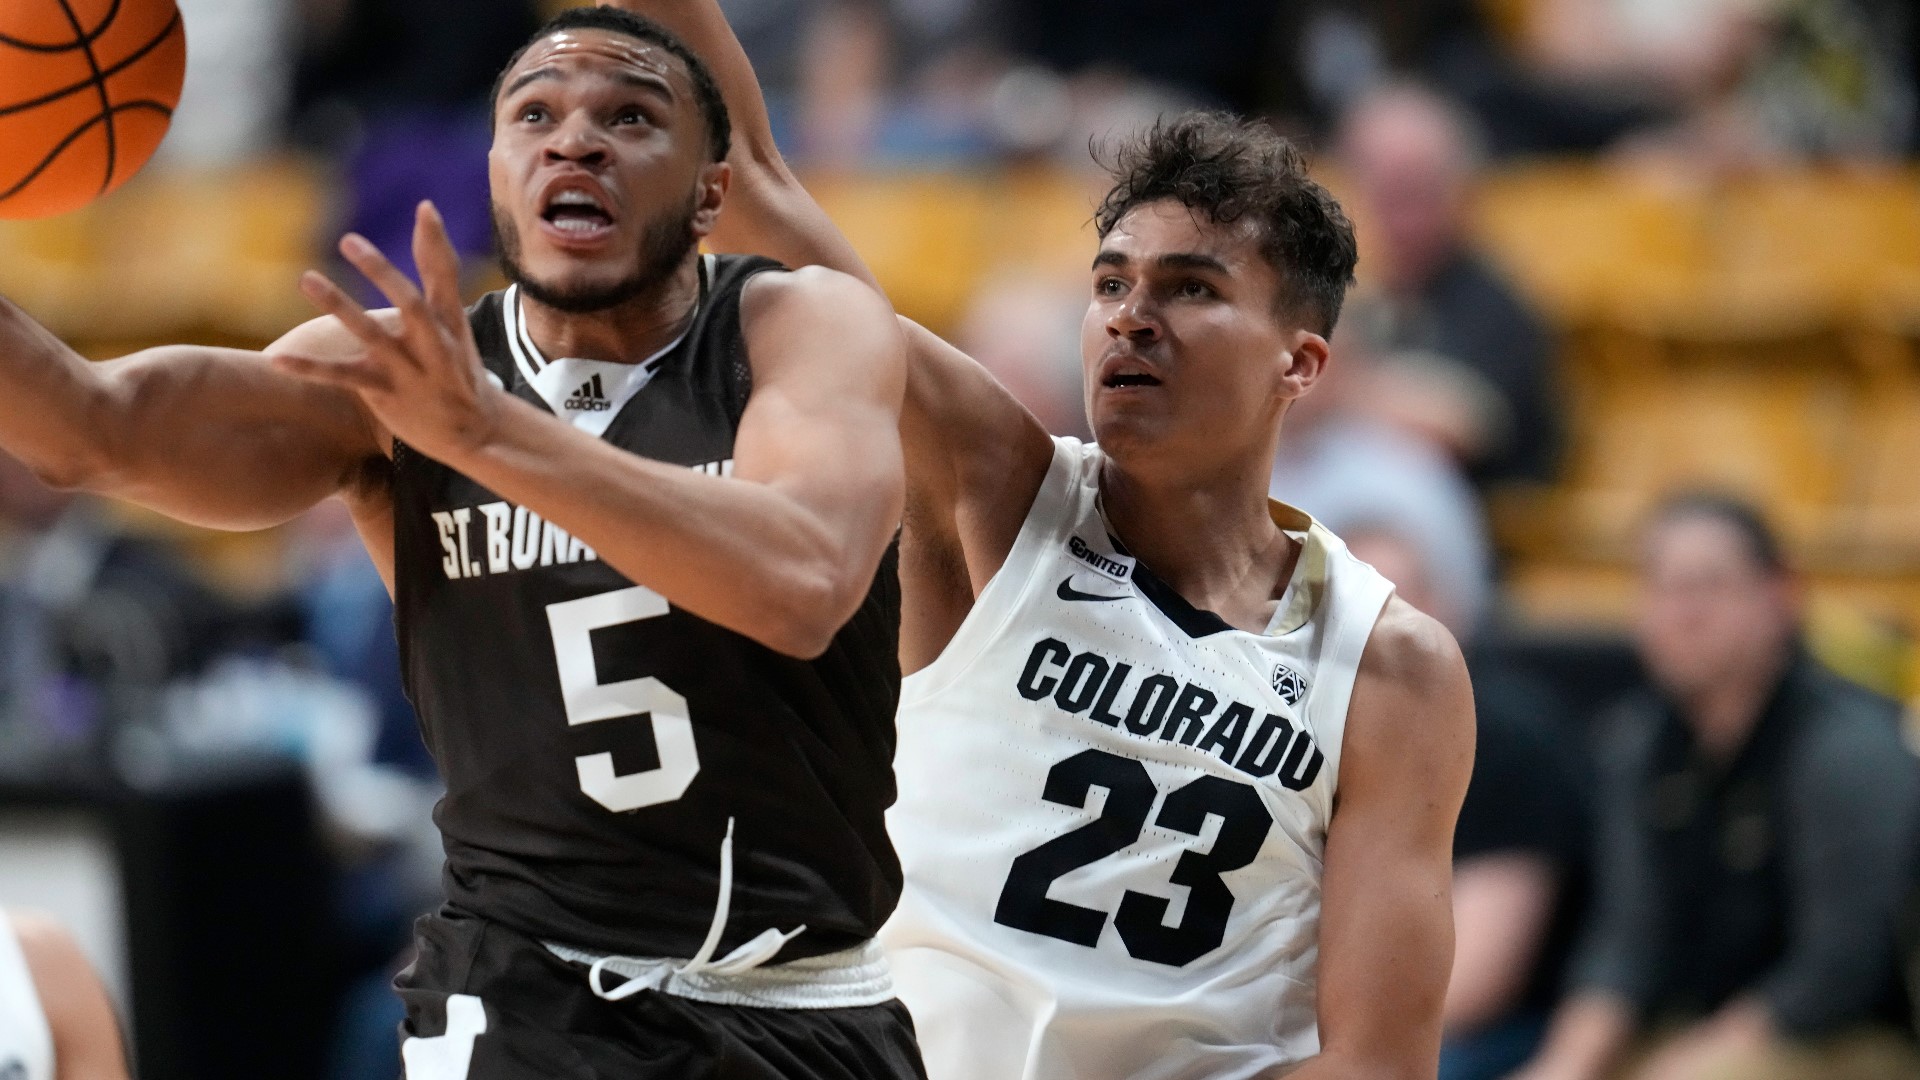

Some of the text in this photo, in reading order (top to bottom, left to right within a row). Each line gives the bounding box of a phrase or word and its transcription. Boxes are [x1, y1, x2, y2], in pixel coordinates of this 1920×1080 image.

[565, 396, 611, 411] adidas
[431, 501, 598, 579] ST. BONA
[545, 587, 700, 812] 5
[1016, 637, 1325, 792] COLORADO
[994, 748, 1274, 967] 23
